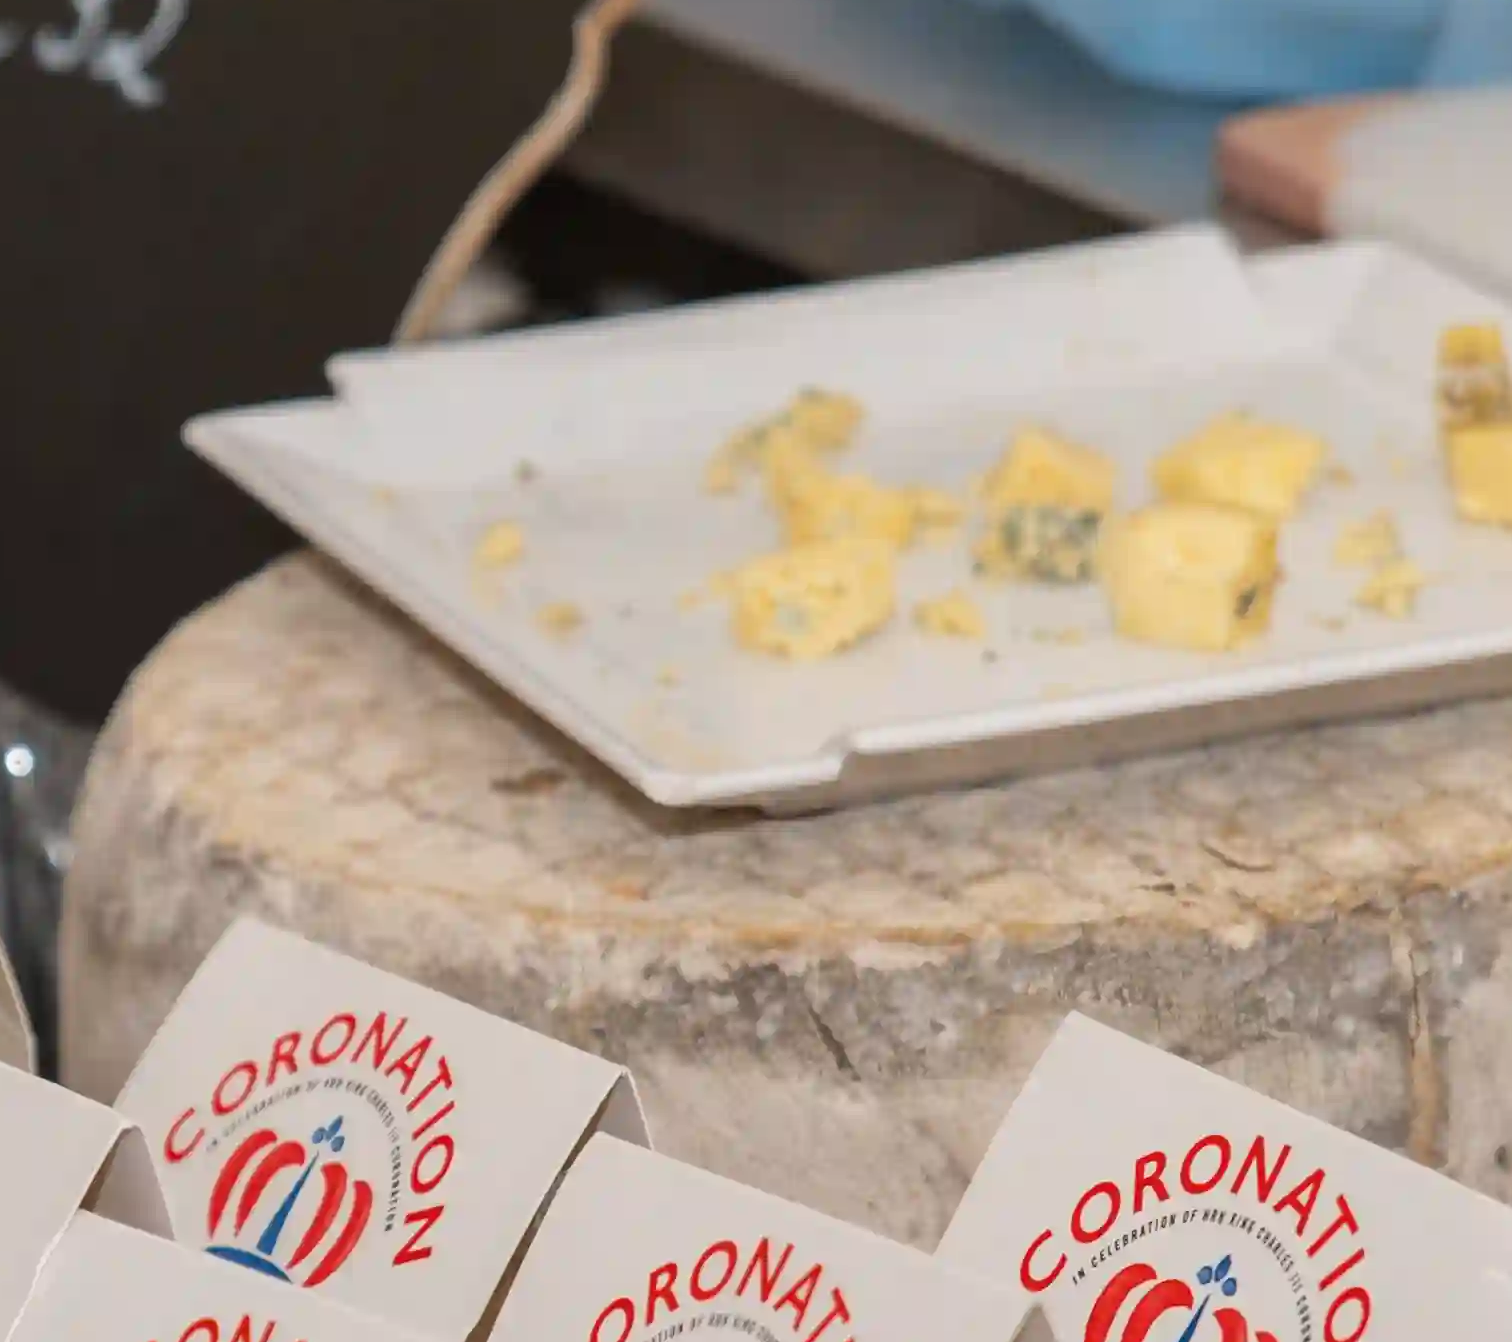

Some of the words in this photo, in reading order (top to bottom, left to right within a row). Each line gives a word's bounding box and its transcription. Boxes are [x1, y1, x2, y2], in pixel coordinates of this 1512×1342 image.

[164, 1011, 456, 1267] CORONATION
[1072, 1268, 1086, 1286] IN
[1090, 1214, 1177, 1267] CELEBRATION
[1182, 1209, 1196, 1224] OF
[1230, 1211, 1255, 1235] KING
[1256, 1226, 1293, 1274] CHARLES
